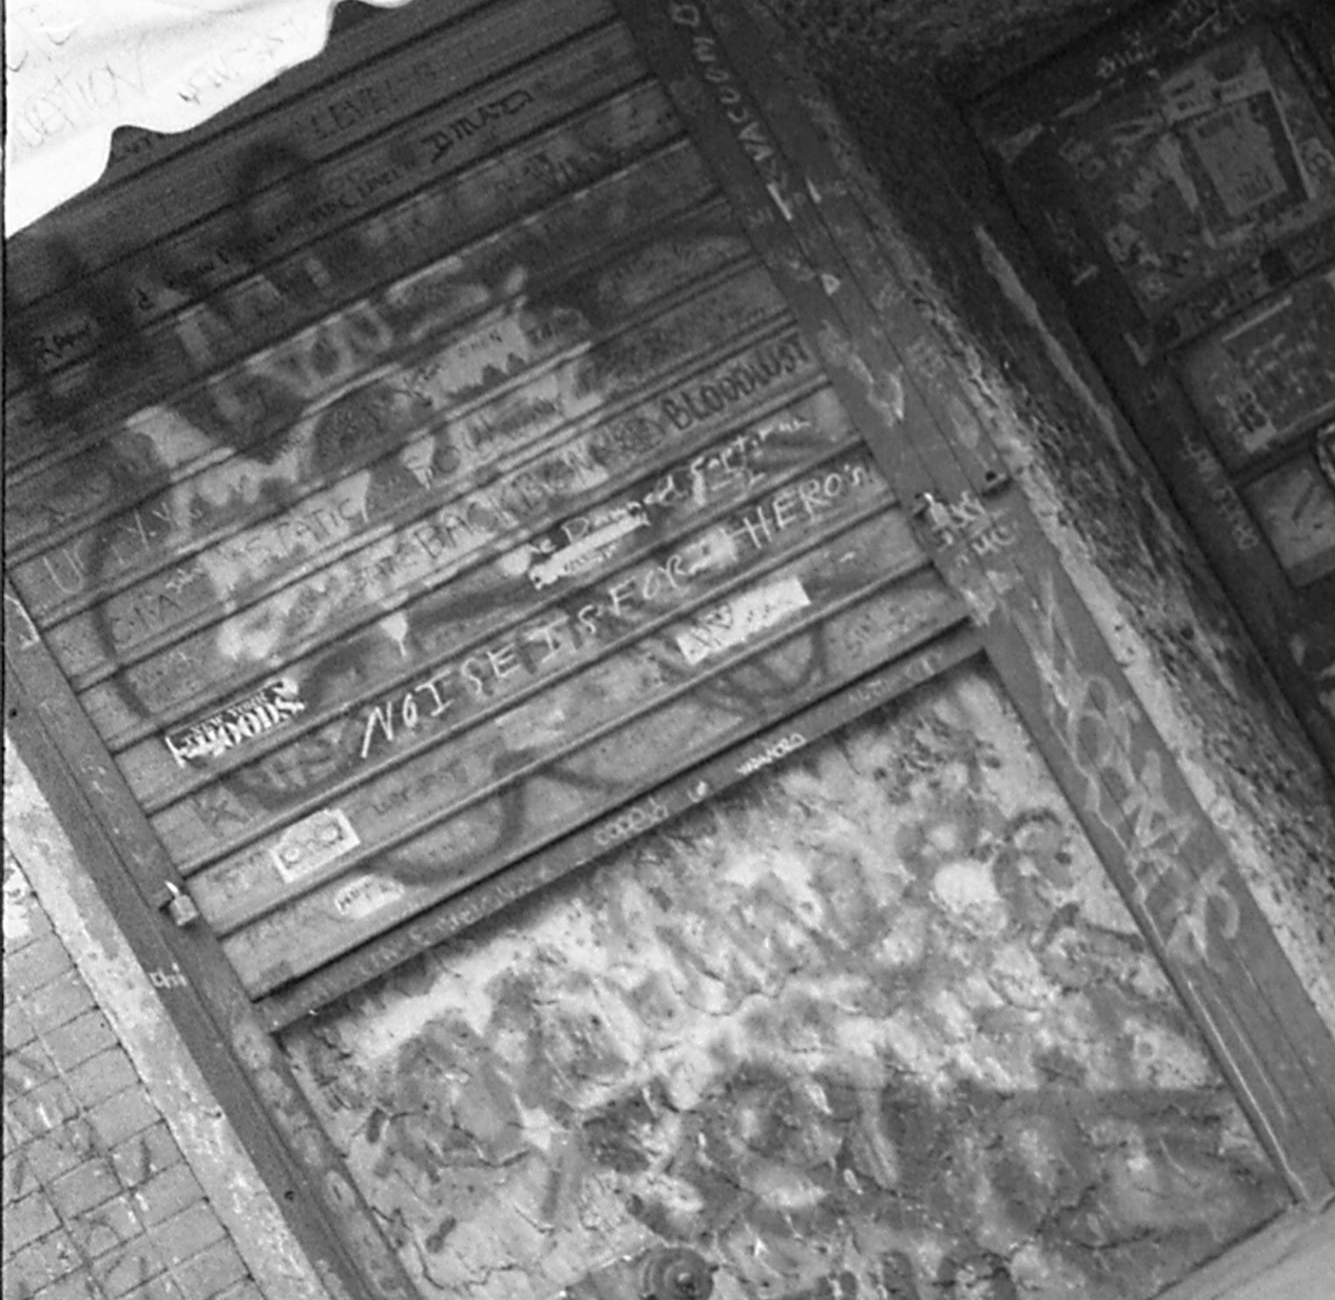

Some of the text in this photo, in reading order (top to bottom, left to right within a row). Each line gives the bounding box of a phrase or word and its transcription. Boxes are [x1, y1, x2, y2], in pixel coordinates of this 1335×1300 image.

[658, 329, 813, 432] BLOODLUST
[362, 642, 524, 758] NOISE
[521, 599, 607, 667] IS
